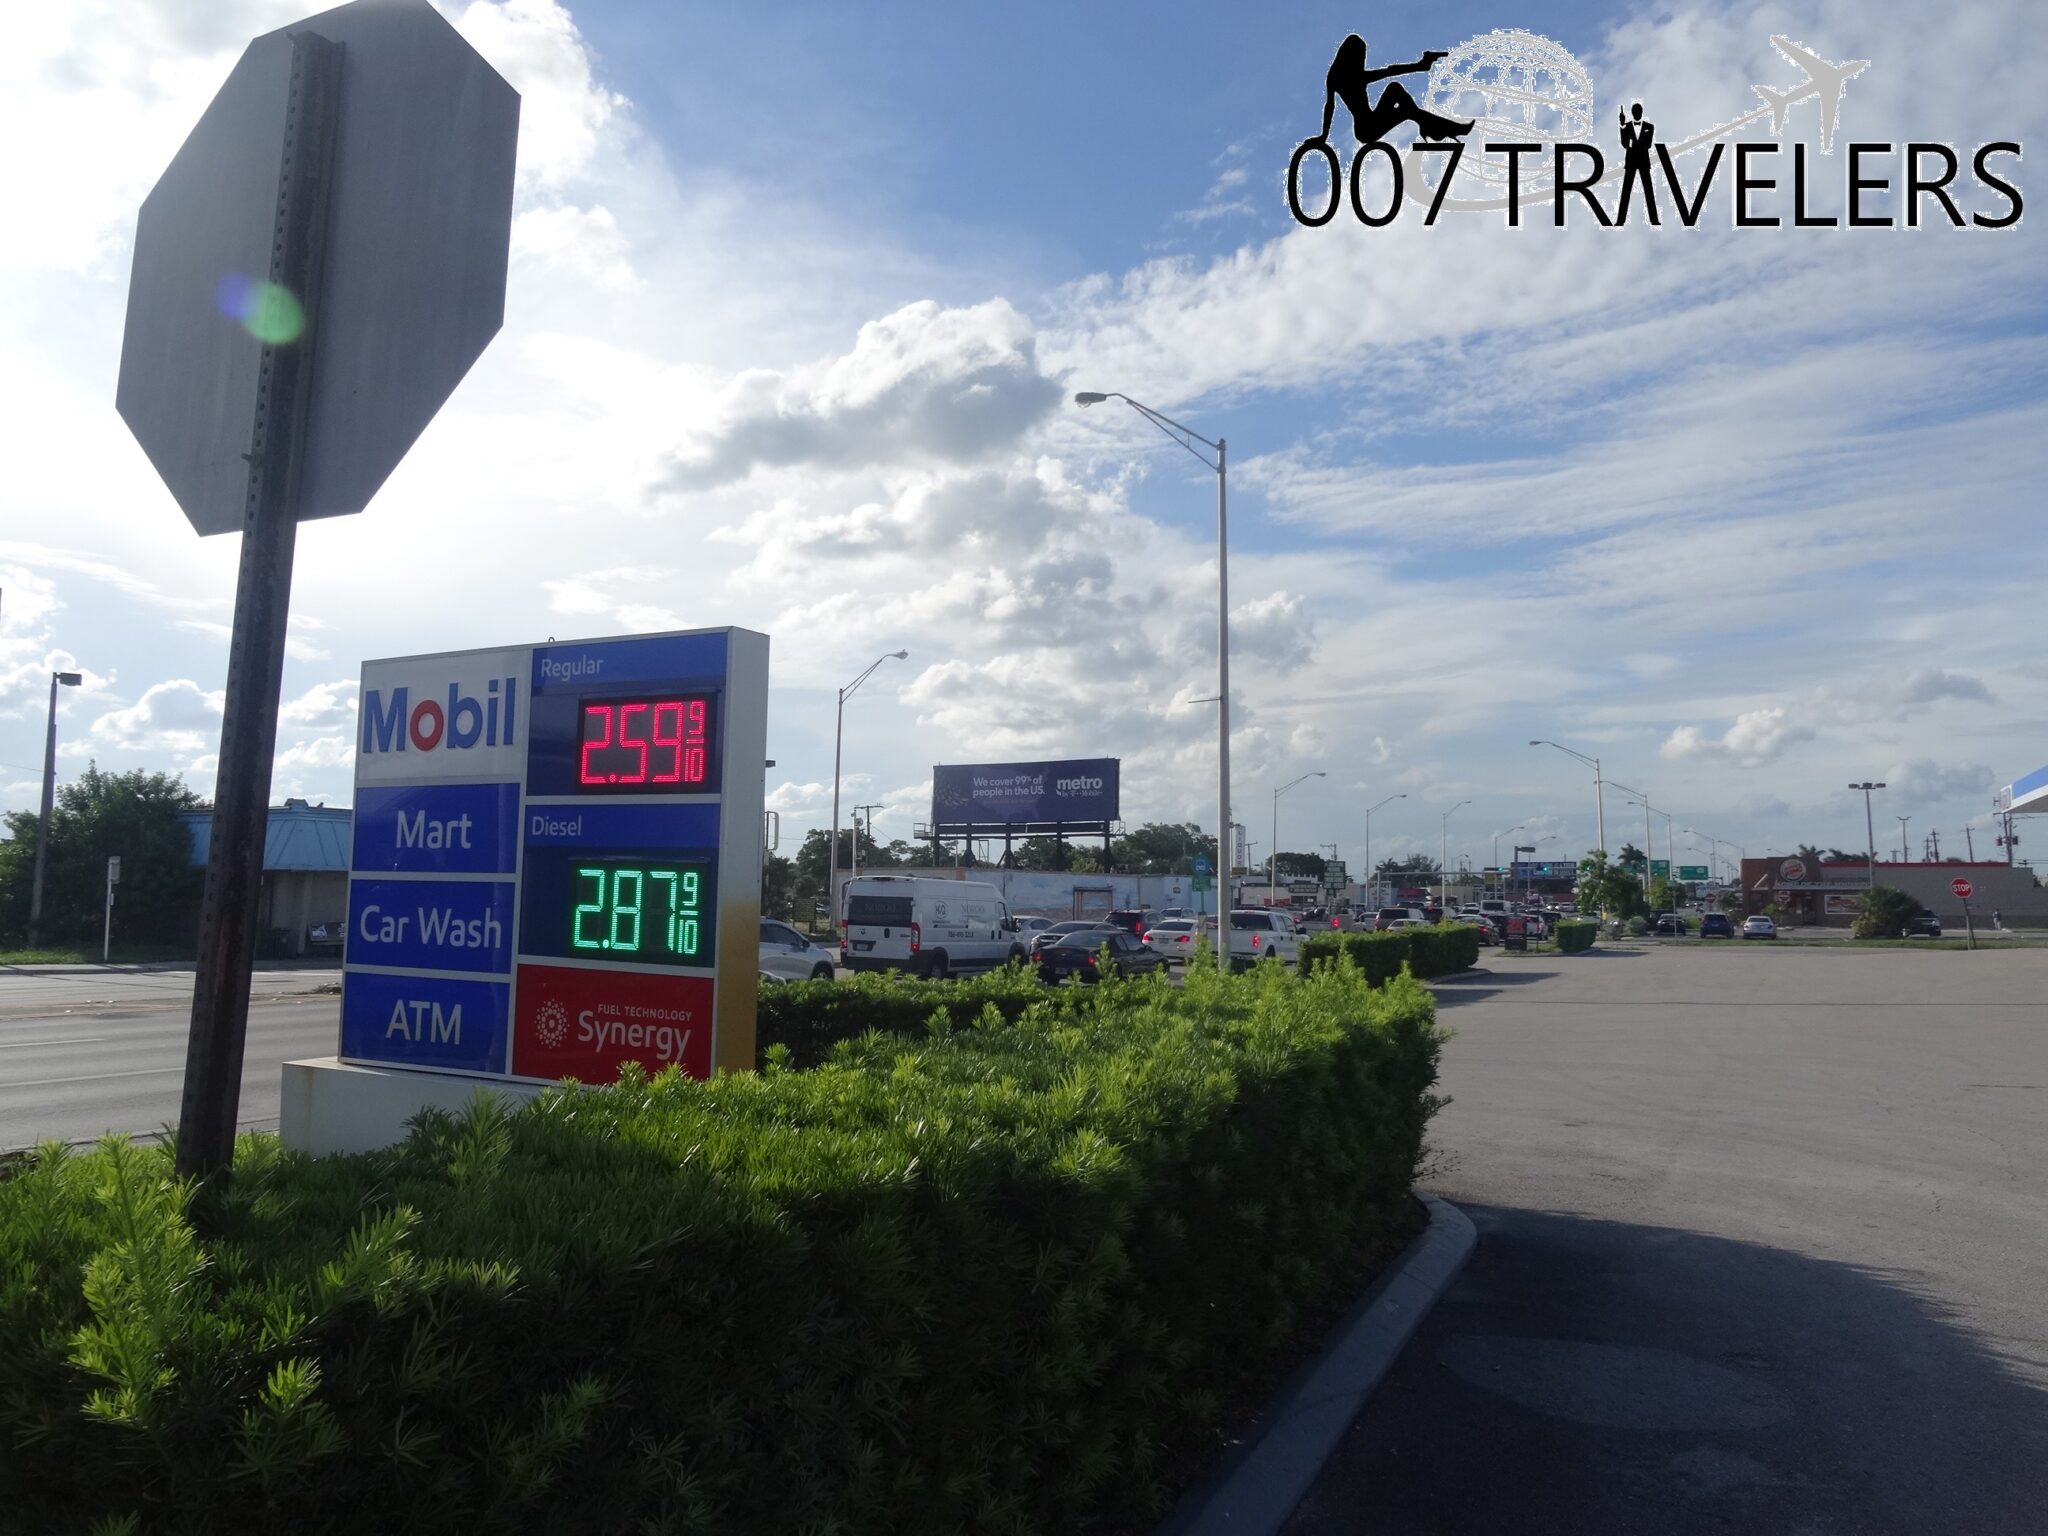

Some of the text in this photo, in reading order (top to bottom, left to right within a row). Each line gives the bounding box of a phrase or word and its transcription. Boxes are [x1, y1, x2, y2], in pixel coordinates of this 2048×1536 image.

[541, 655, 603, 682] Regular
[363, 677, 516, 753] Mobil
[973, 777, 988, 787] We
[989, 778, 1013, 787] cover
[1033, 775, 1042, 785] of
[973, 787, 1003, 798] people
[1004, 787, 1013, 796] in
[1014, 786, 1029, 796] the
[1057, 775, 1103, 790] metro
[396, 810, 472, 849] Mart
[532, 816, 582, 836] Diesel
[1952, 883, 1970, 892] STOP
[360, 905, 501, 949] Car Wash
[385, 999, 462, 1045] ATM
[598, 1003, 692, 1022] FUEL TECHNOLOGY
[578, 1010, 692, 1063] Synergy
